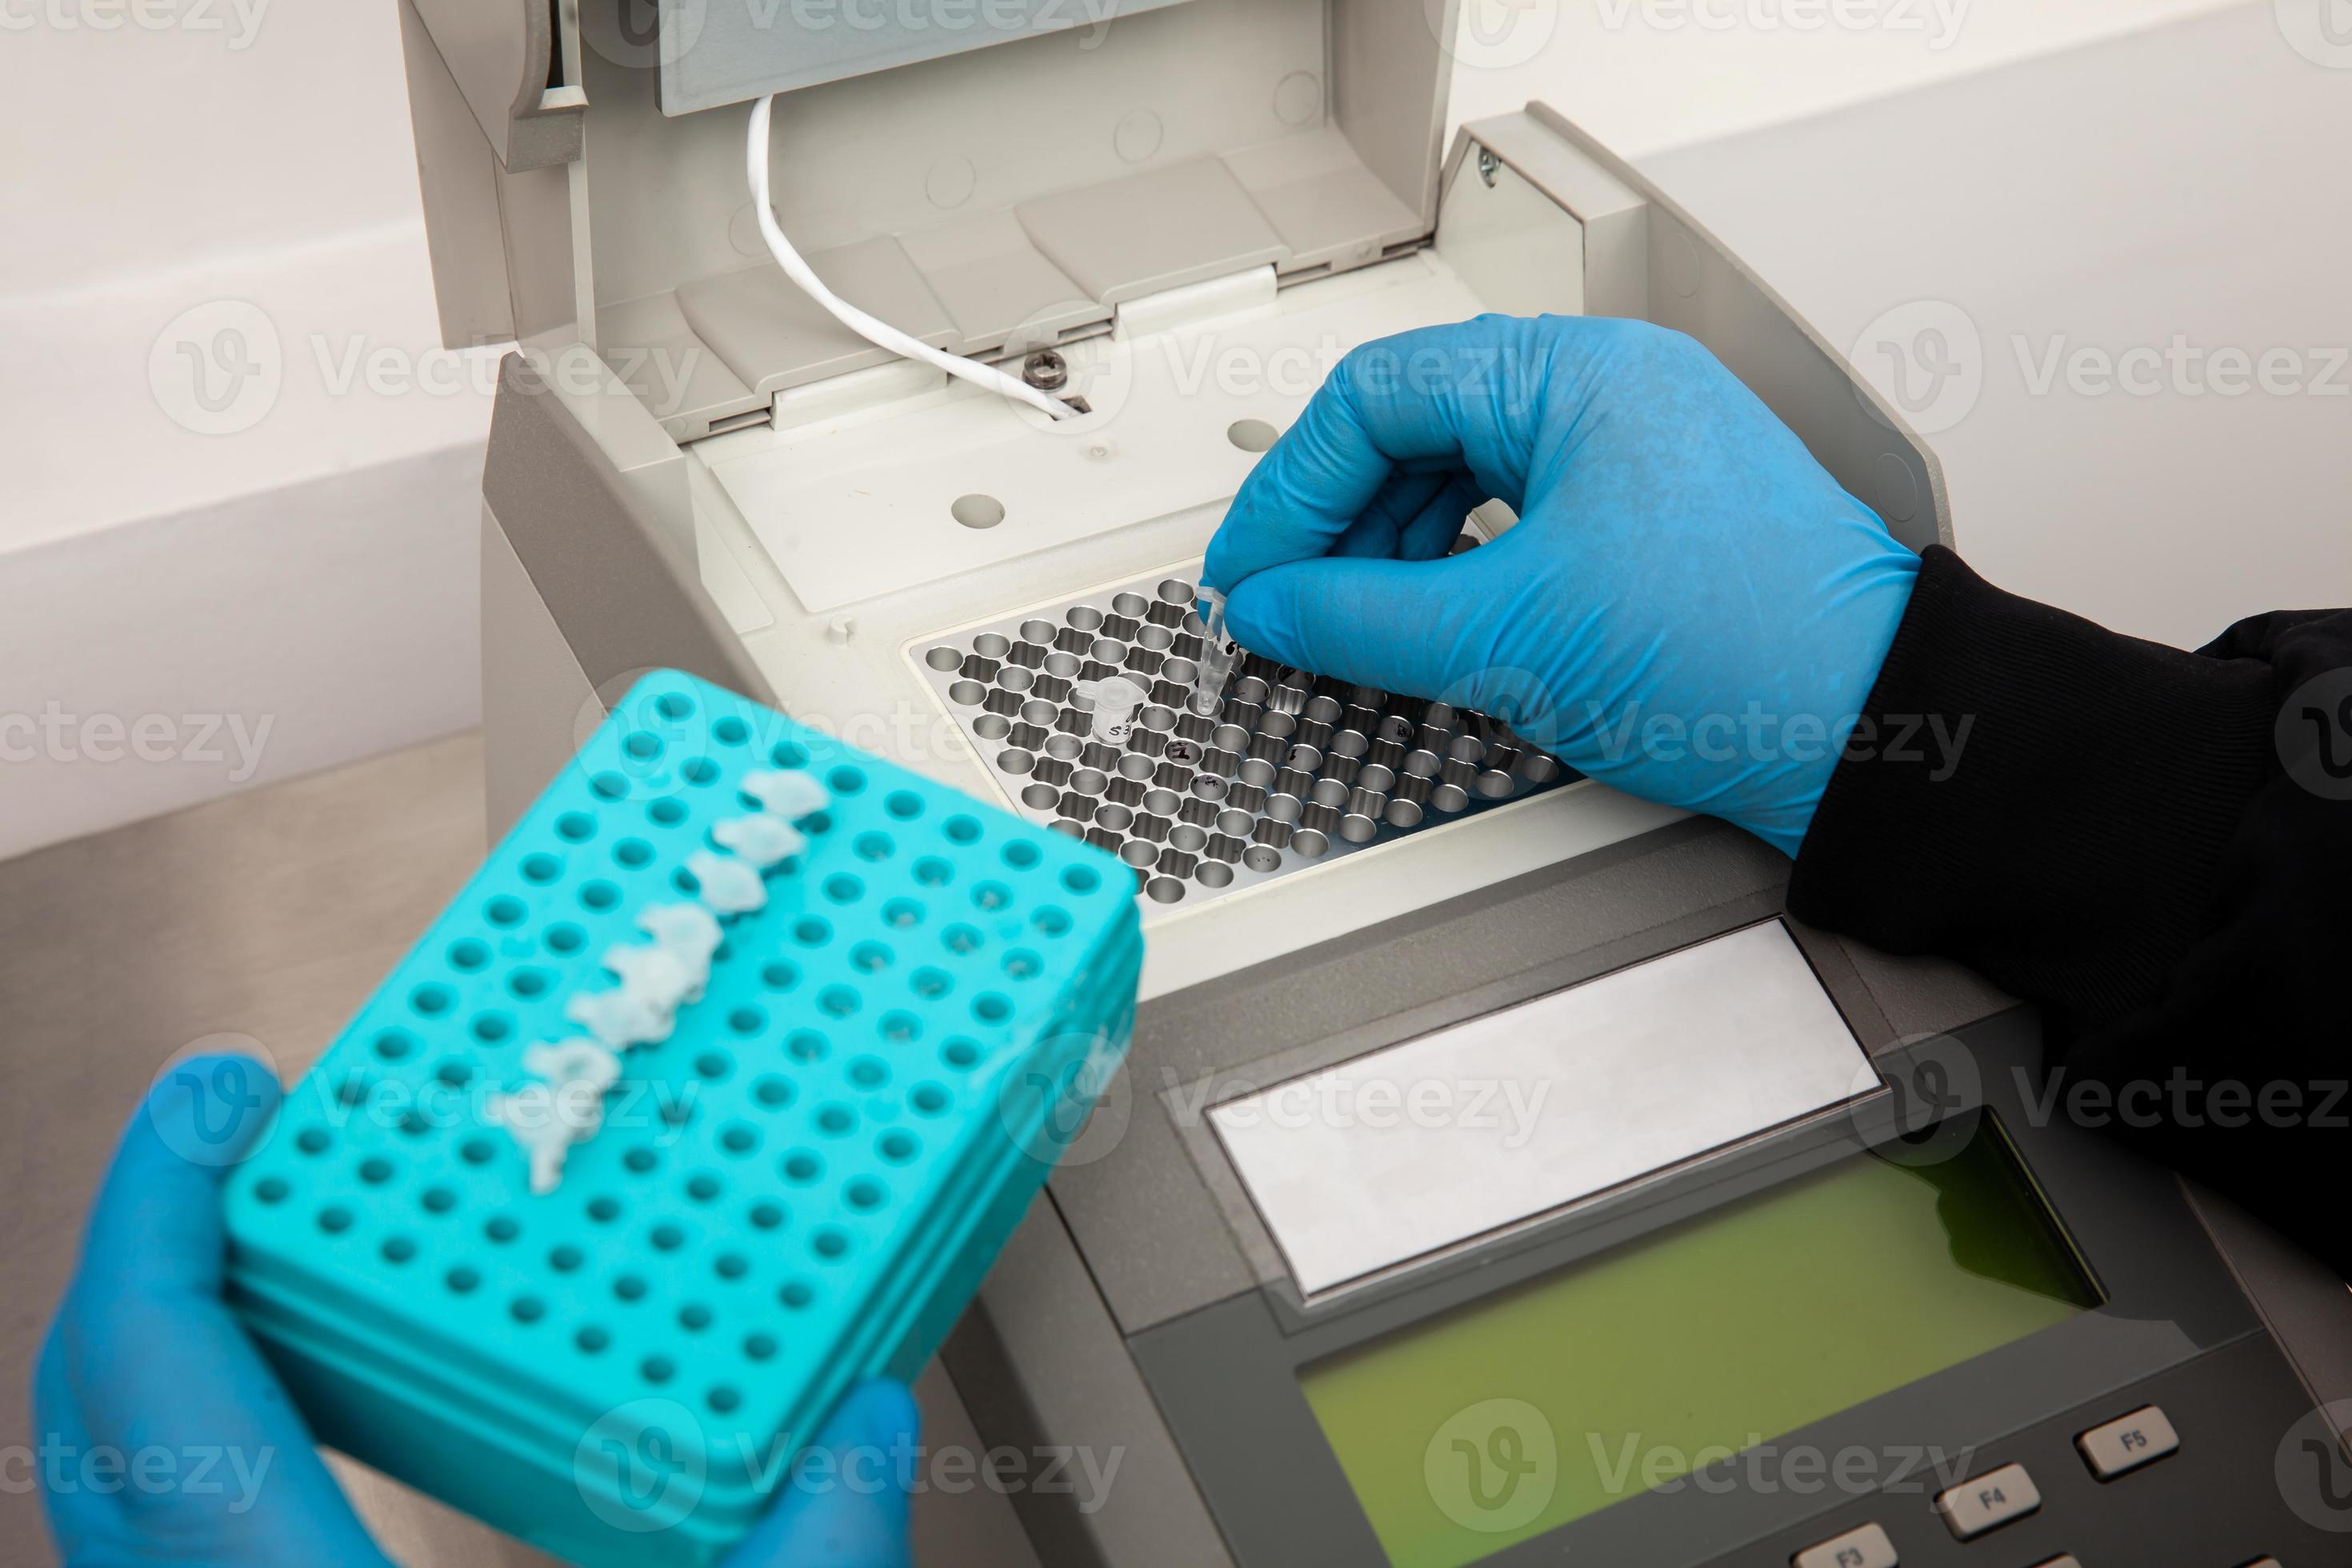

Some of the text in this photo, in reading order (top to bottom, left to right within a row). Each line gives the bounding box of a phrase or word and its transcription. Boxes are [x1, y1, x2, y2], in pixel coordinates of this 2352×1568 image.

[2120, 1429, 2147, 1452] F5
[1978, 1487, 2006, 1510] F4
[1835, 1547, 1863, 1568] F3
